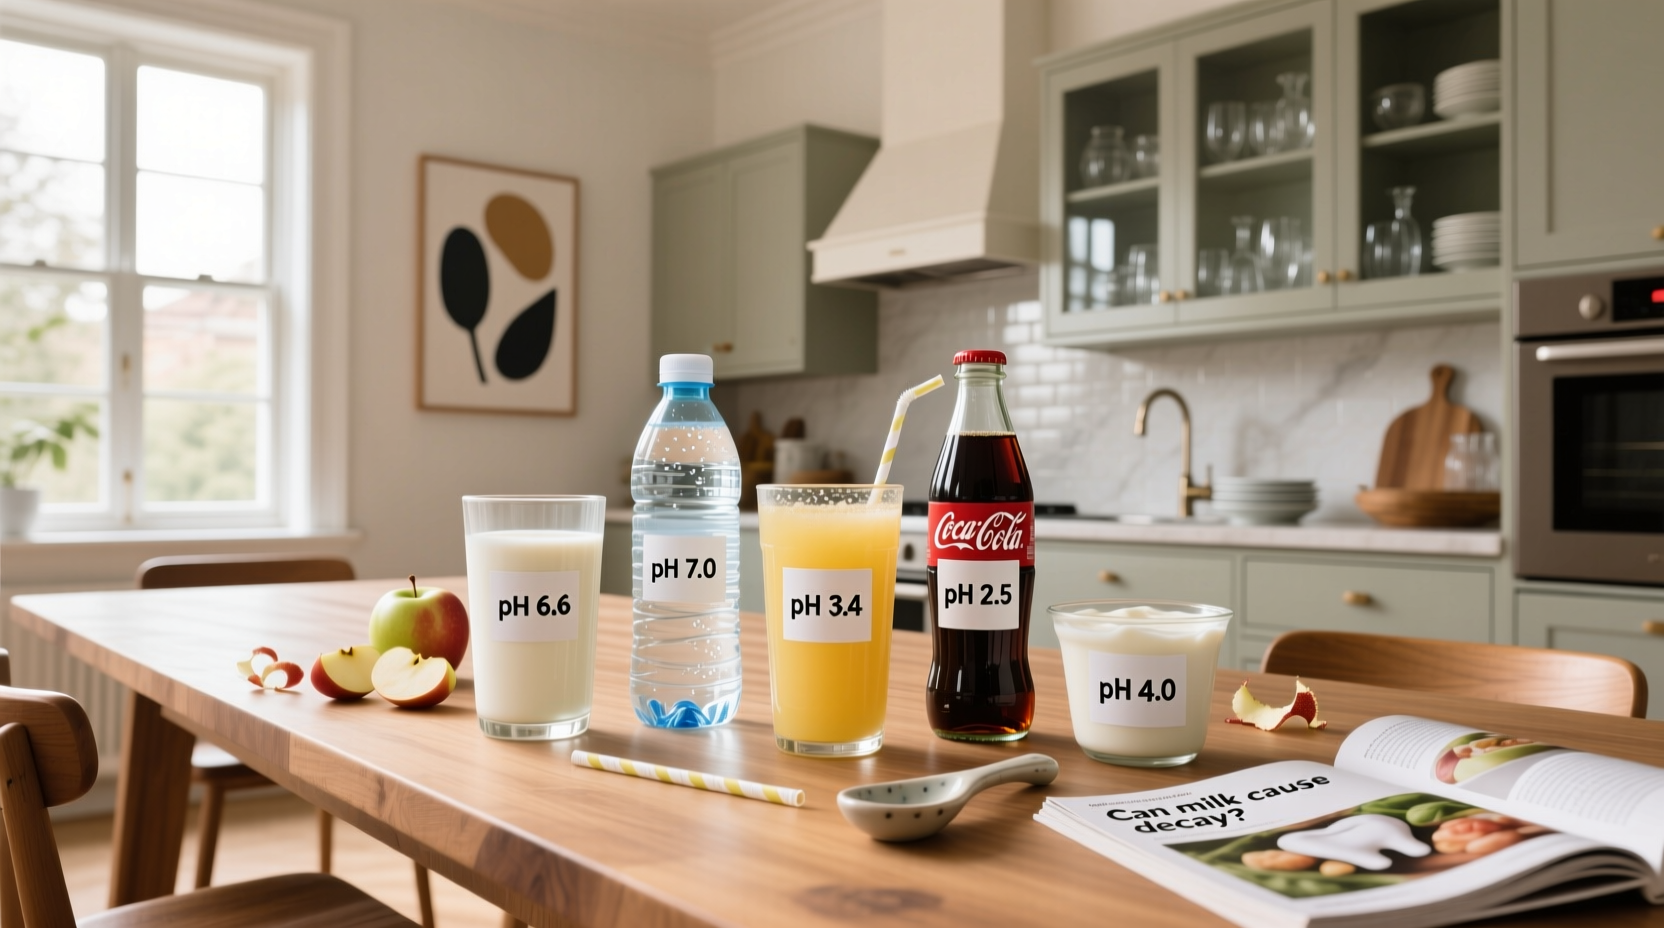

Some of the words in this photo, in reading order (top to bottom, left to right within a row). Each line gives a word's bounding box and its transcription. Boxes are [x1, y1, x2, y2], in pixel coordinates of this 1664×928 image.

[651, 558, 679, 583] pH
[685, 557, 717, 579] 7.0
[499, 595, 529, 622] pH
[536, 593, 571, 617] 6.6
[791, 594, 821, 620] pH
[828, 594, 863, 617] 3.4
[945, 583, 973, 609] pH
[980, 583, 1012, 606] 2.5
[1099, 677, 1131, 704] pH
[1137, 678, 1176, 702] 4.0
[1106, 807, 1171, 821] Can
[1176, 793, 1243, 814] milk
[1247, 776, 1330, 801] cause
[1134, 808, 1245, 833] decay?
